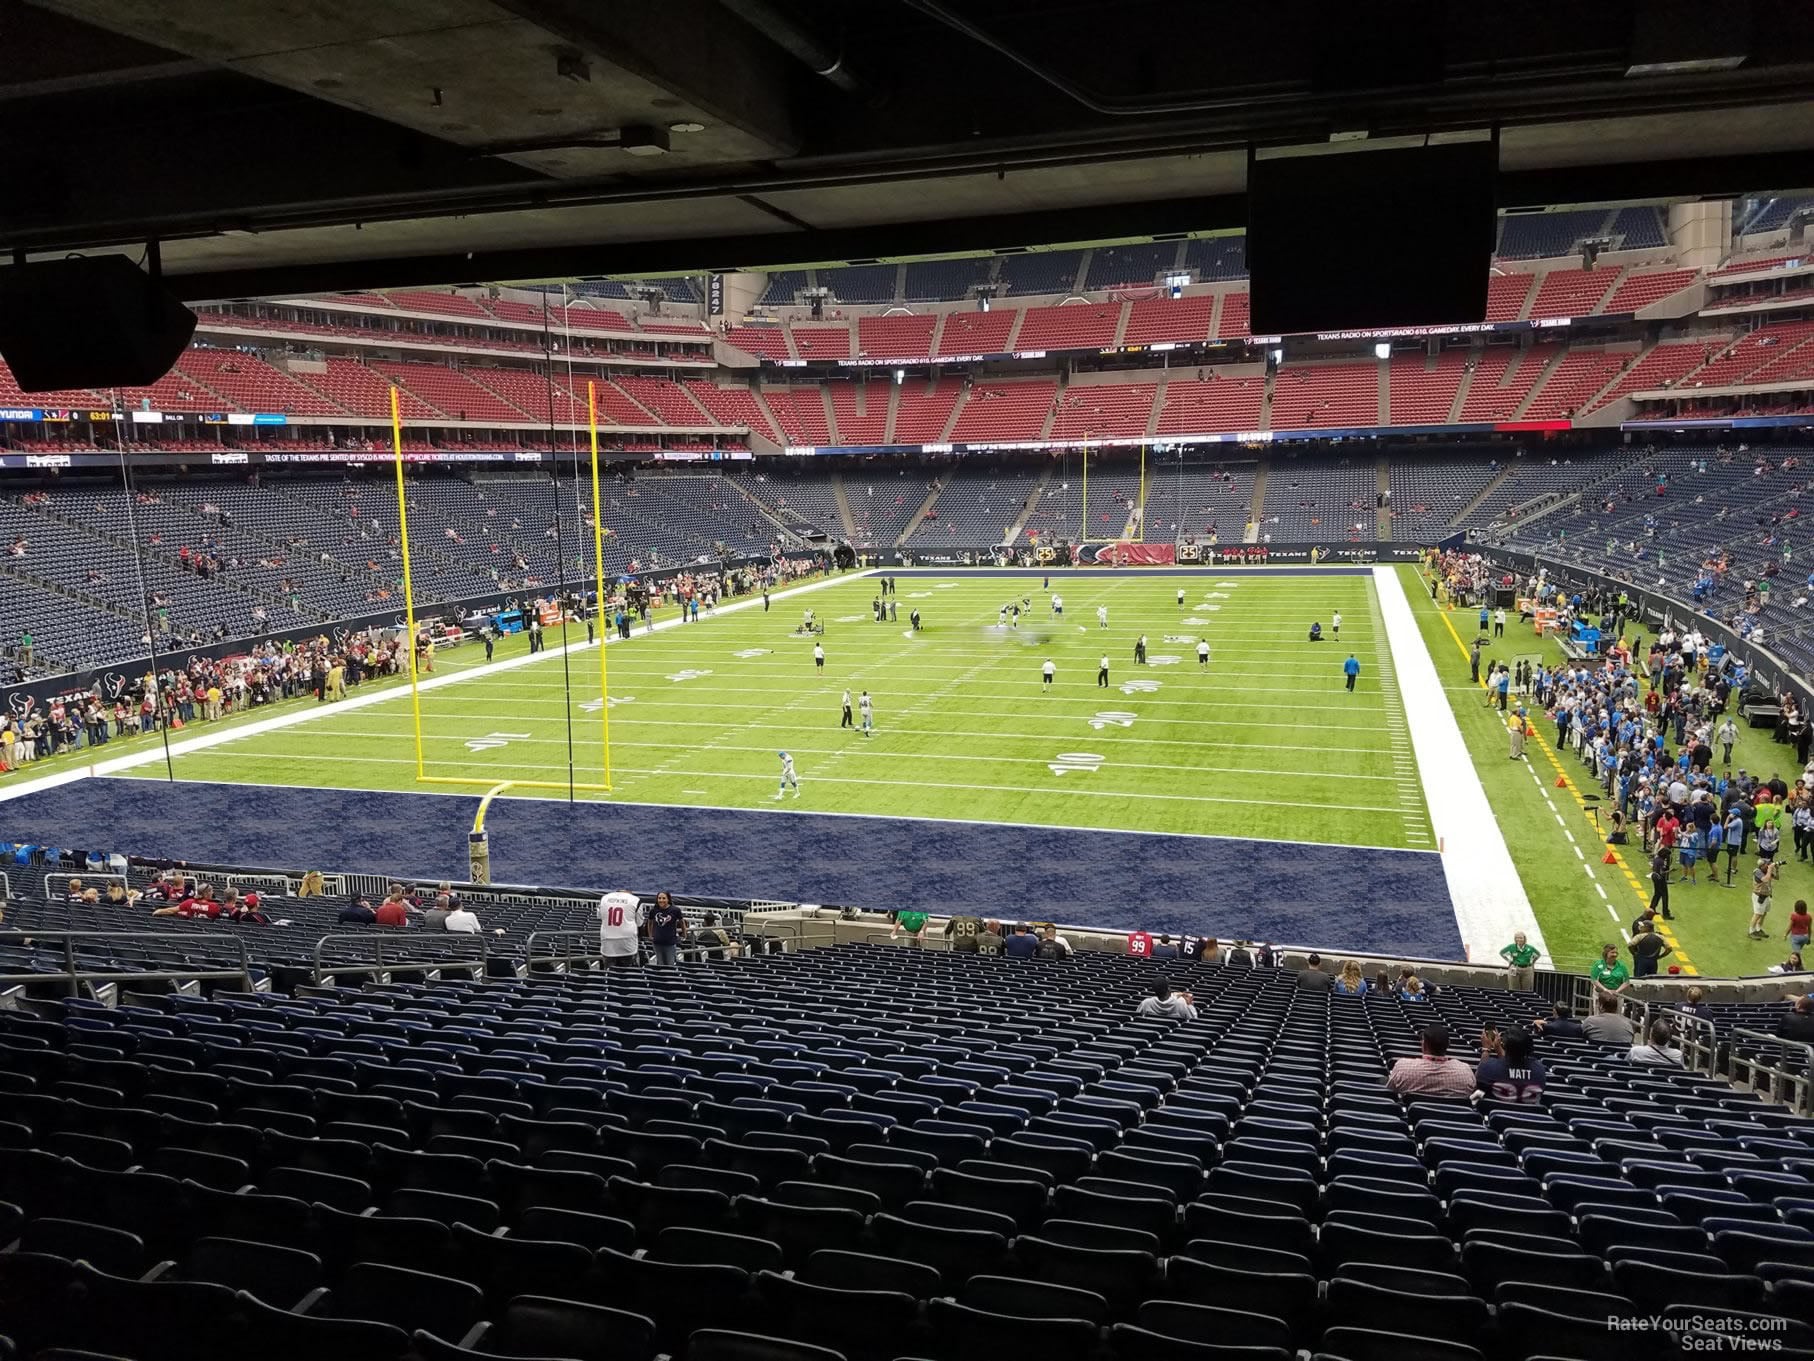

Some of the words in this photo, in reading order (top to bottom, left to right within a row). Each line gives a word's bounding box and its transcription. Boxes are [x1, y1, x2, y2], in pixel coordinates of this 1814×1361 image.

[1317, 333, 1340, 341] TEXANS
[1372, 328, 1415, 338] SPORTSRADIO
[1460, 324, 1480, 333] EVERY
[0, 409, 33, 419] YUNDAI
[89, 411, 111, 421] 63:01
[265, 454, 281, 462] TASTE
[281, 454, 289, 462] OF
[289, 454, 300, 462] THE
[300, 454, 320, 462] TEXANS
[1039, 550, 1051, 559] 25
[1182, 547, 1196, 557] 25
[46, 691, 93, 704] TEXAN
[1047, 752, 1105, 772] 10
[607, 906, 624, 927] 10
[956, 922, 976, 937] 99
[1131, 940, 1146, 954] 99
[1183, 941, 1195, 955] 15
[1272, 951, 1284, 968] 12
[1508, 1067, 1532, 1080] WATT
